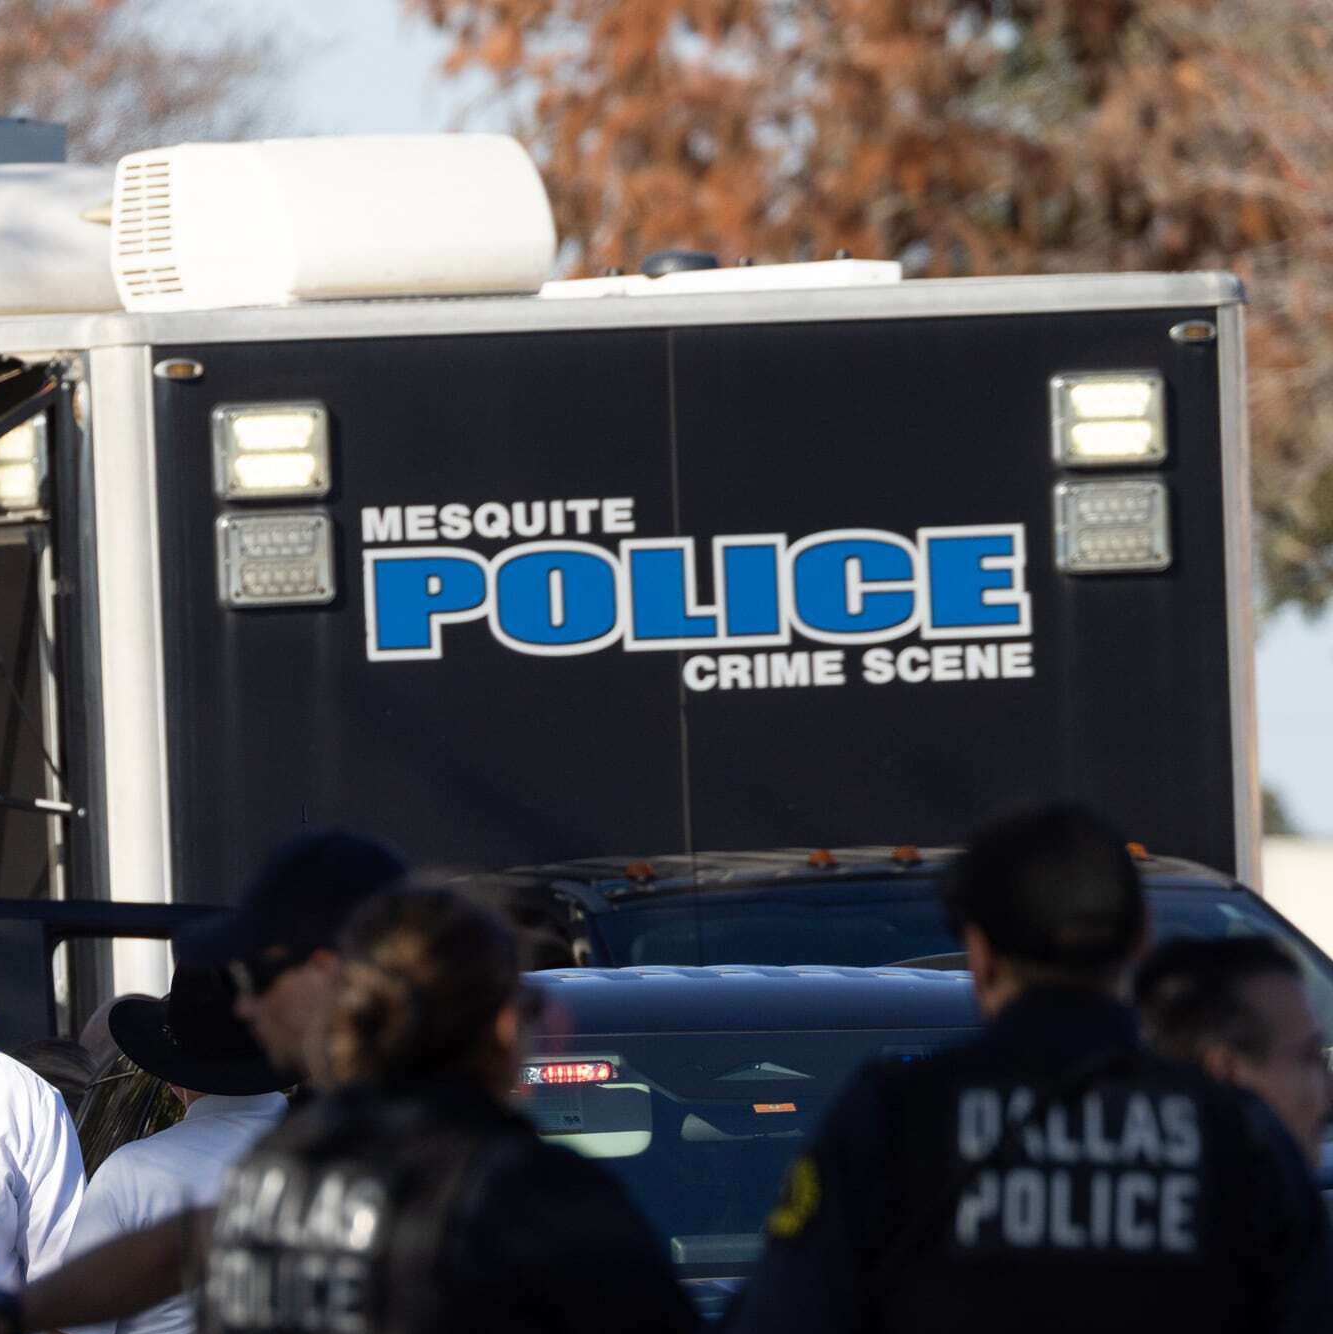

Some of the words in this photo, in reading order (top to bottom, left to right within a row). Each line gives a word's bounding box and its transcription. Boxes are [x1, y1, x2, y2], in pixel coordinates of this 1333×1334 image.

[361, 499, 635, 541] MESQUITE
[363, 523, 1032, 662] POLICE
[683, 652, 847, 691] CRIME
[862, 643, 1035, 684] SCENE
[955, 1168, 1199, 1251] POLICE
